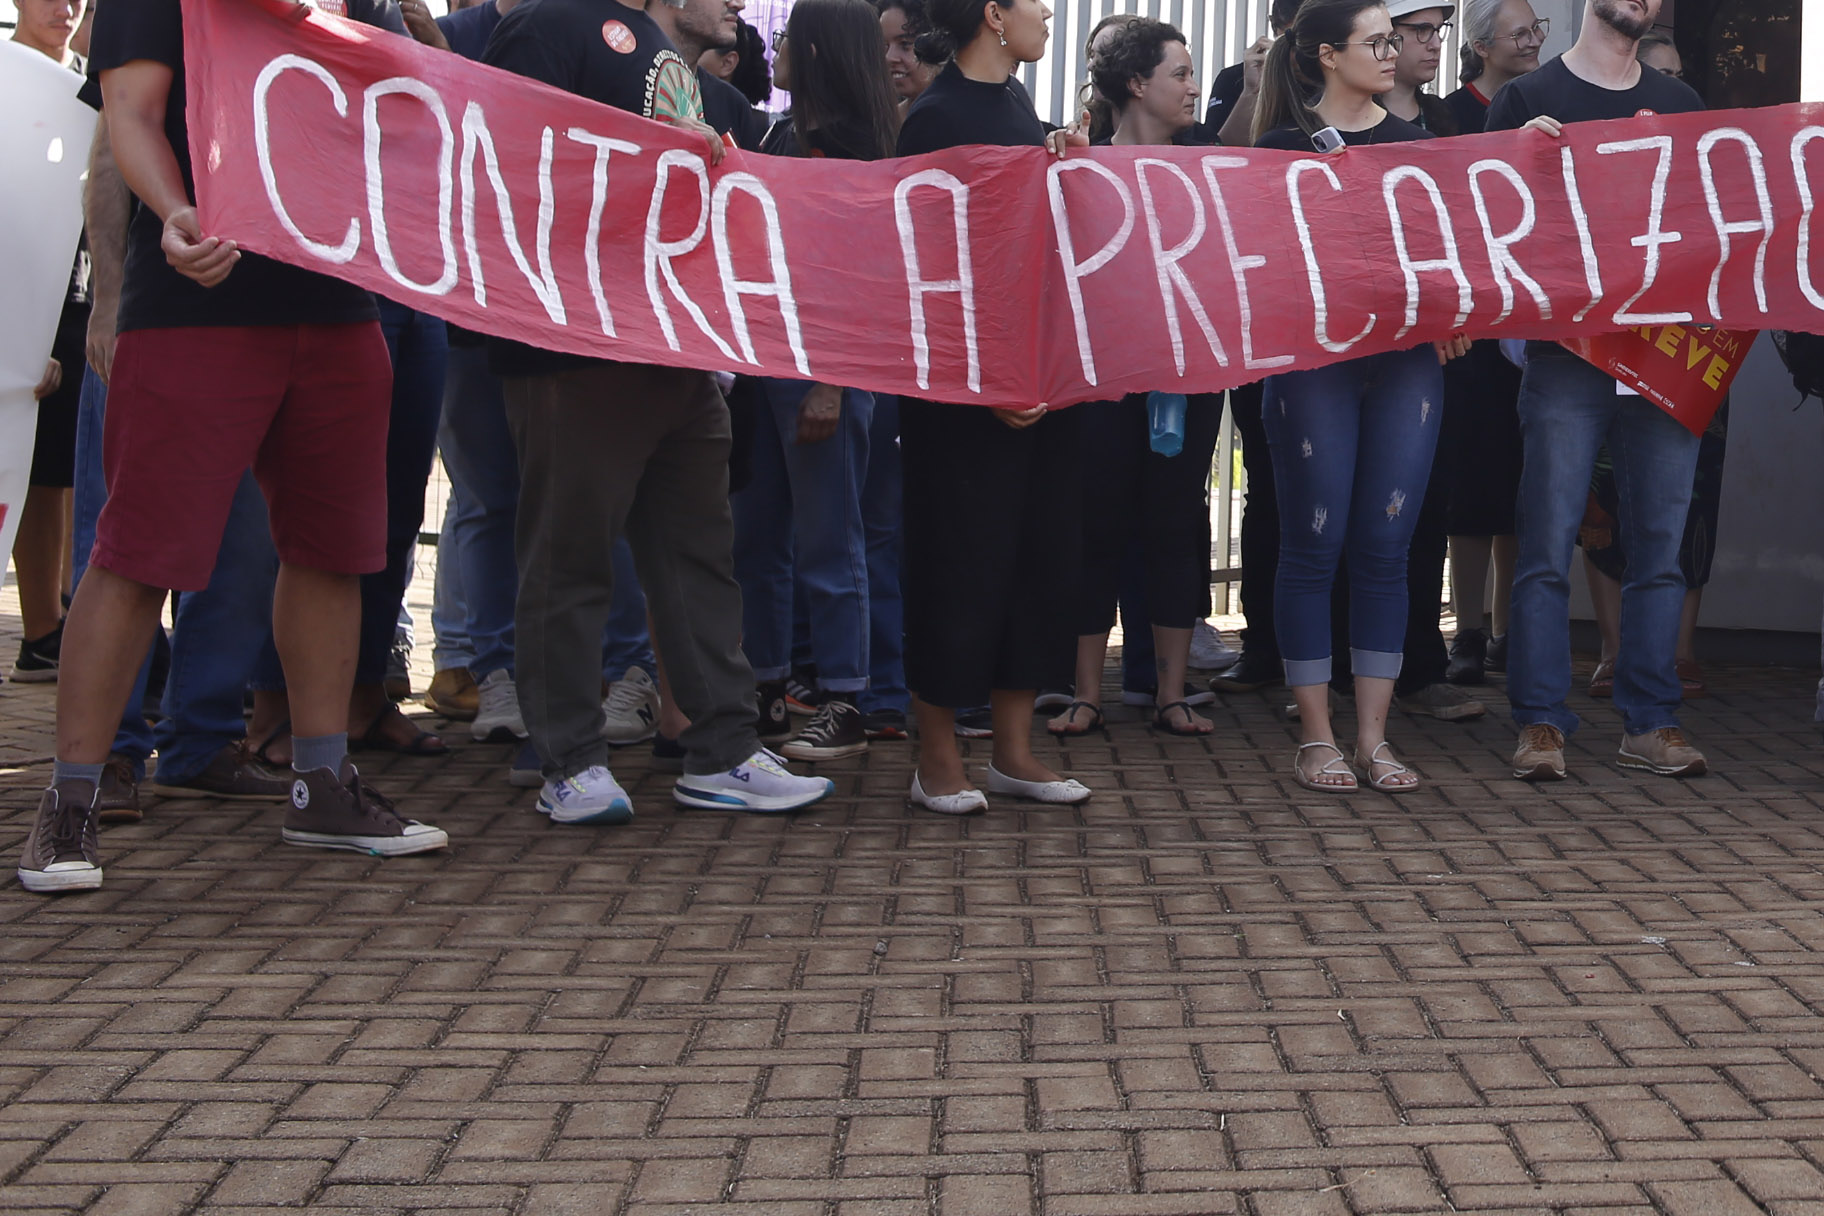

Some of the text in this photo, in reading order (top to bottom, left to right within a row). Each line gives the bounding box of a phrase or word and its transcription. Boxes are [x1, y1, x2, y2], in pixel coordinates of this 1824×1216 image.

[643, 68, 660, 117] UCAÇÃO,
[253, 53, 812, 377] CONTRA
[893, 168, 982, 393] A
